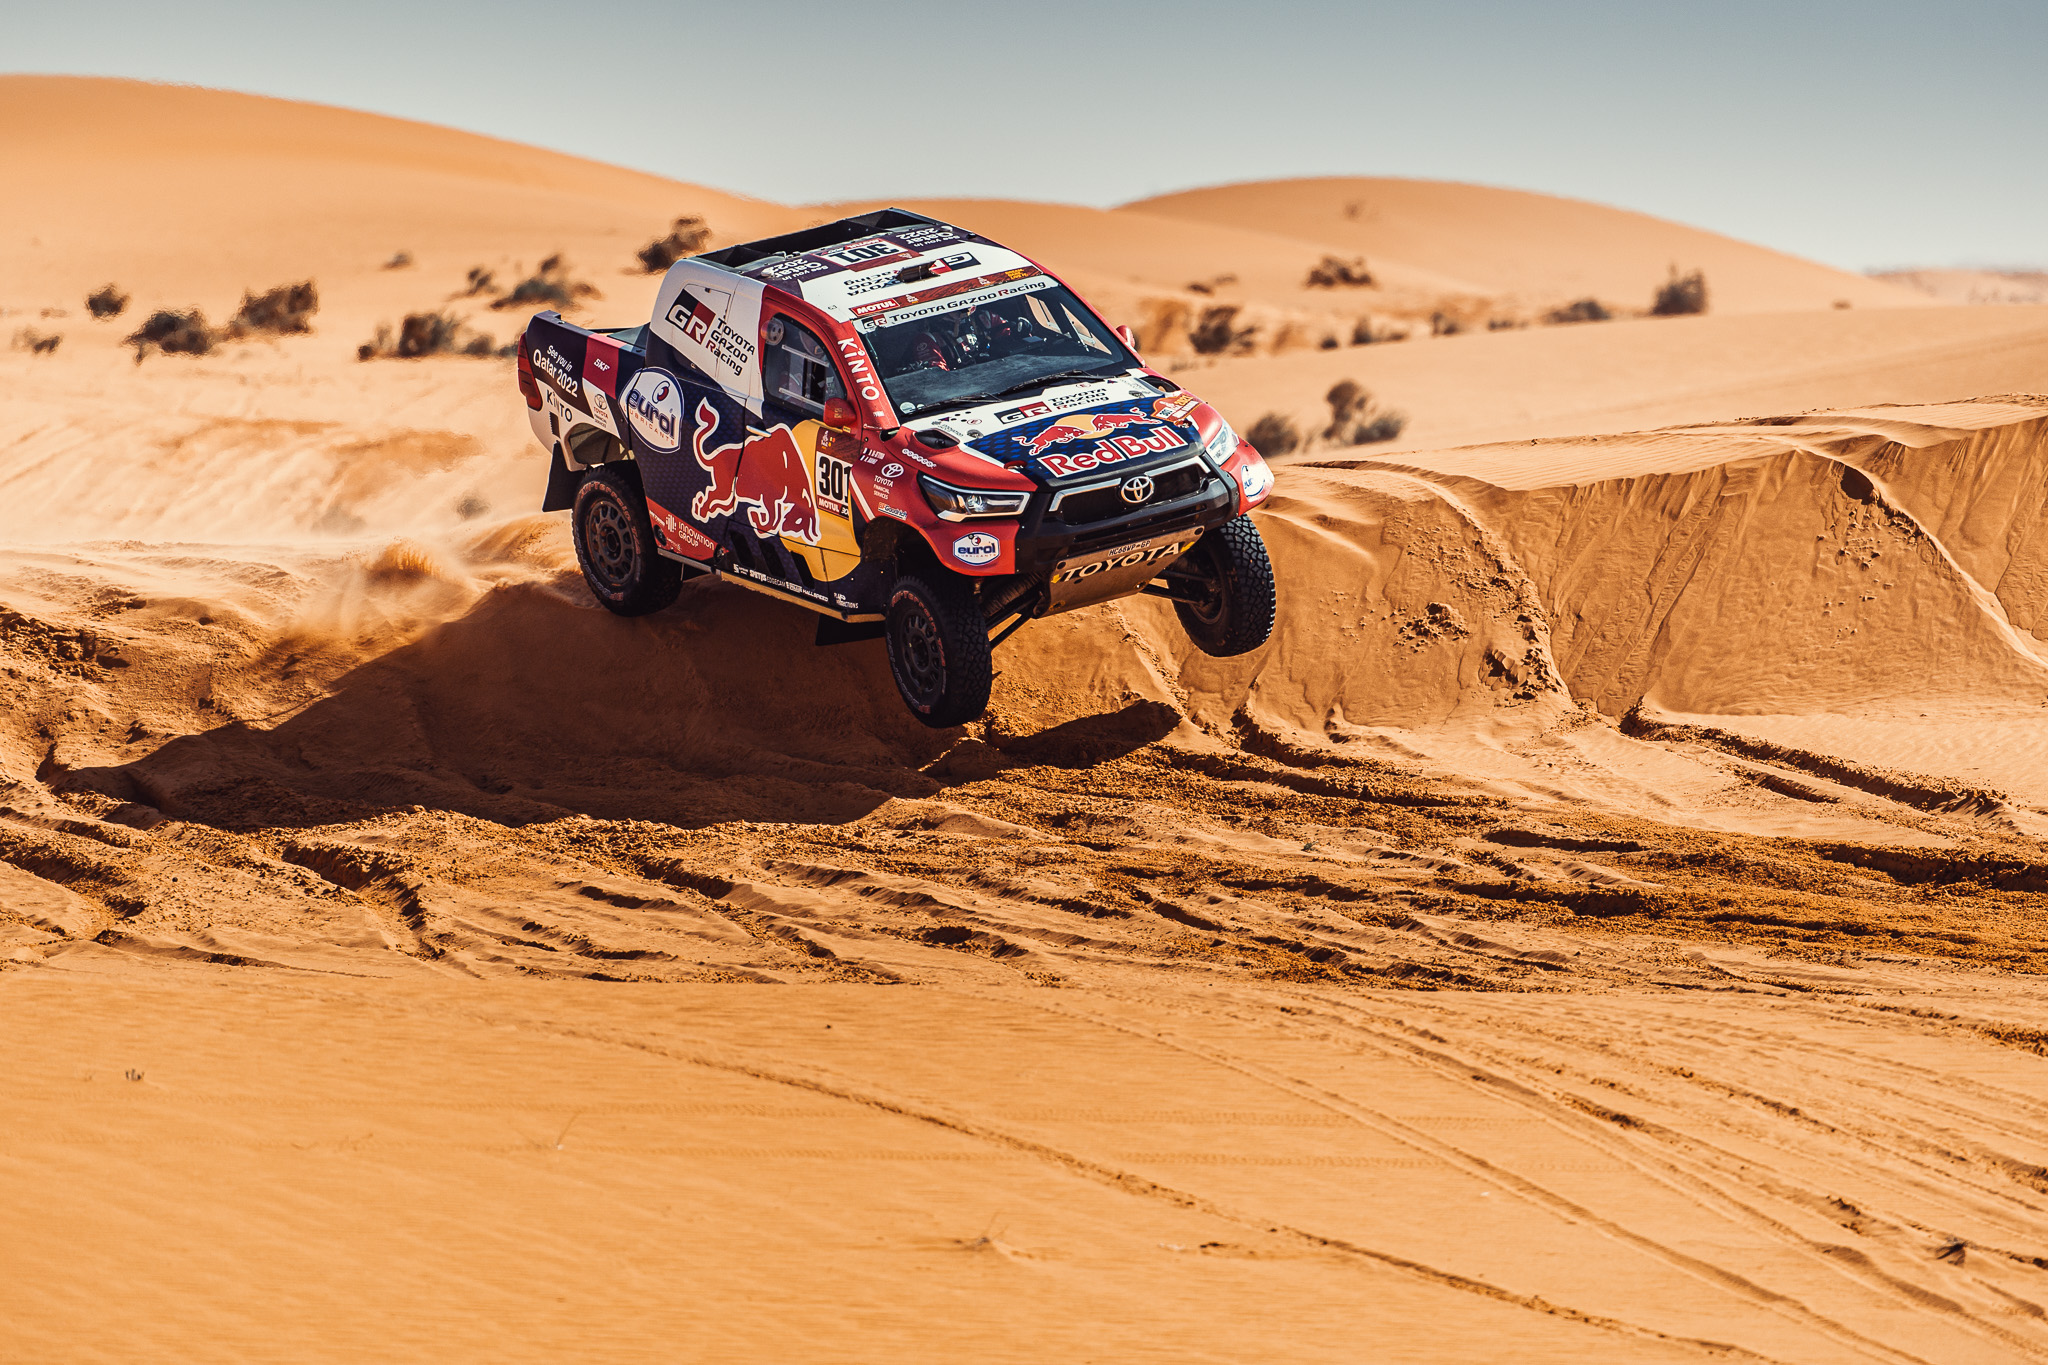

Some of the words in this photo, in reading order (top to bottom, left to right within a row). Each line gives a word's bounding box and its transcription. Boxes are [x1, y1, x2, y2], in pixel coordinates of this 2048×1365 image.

[906, 232, 954, 244] Qatar
[830, 243, 899, 263] 301
[774, 262, 822, 279] Qatar
[794, 269, 810, 278] you
[847, 280, 902, 296] OYOTA
[848, 276, 897, 290] AZOO
[857, 299, 896, 314] MOTUL
[863, 317, 888, 330] GR
[889, 305, 946, 322] TOYOTA
[947, 293, 997, 309] GAZOO
[998, 281, 1046, 296] Racing
[668, 304, 708, 343] GR
[718, 317, 756, 356] TOYOTA
[710, 330, 748, 364] GAZOO
[547, 345, 558, 359] See
[556, 354, 568, 368] you
[565, 361, 572, 372] in
[593, 358, 610, 372] SKF
[705, 340, 743, 376] Racing
[533, 349, 556, 379] Qatar
[556, 369, 578, 398] 2022
[1048, 388, 1106, 402] TOYOTA
[1057, 396, 1110, 410] Racing
[1001, 406, 1050, 424] GR
[874, 474, 894, 488] TOYOTA
[818, 497, 840, 512] MOTUL
[678, 530, 699, 548] GROUP
[957, 543, 996, 554] eurol
[1063, 542, 1180, 583] TOYOTA
